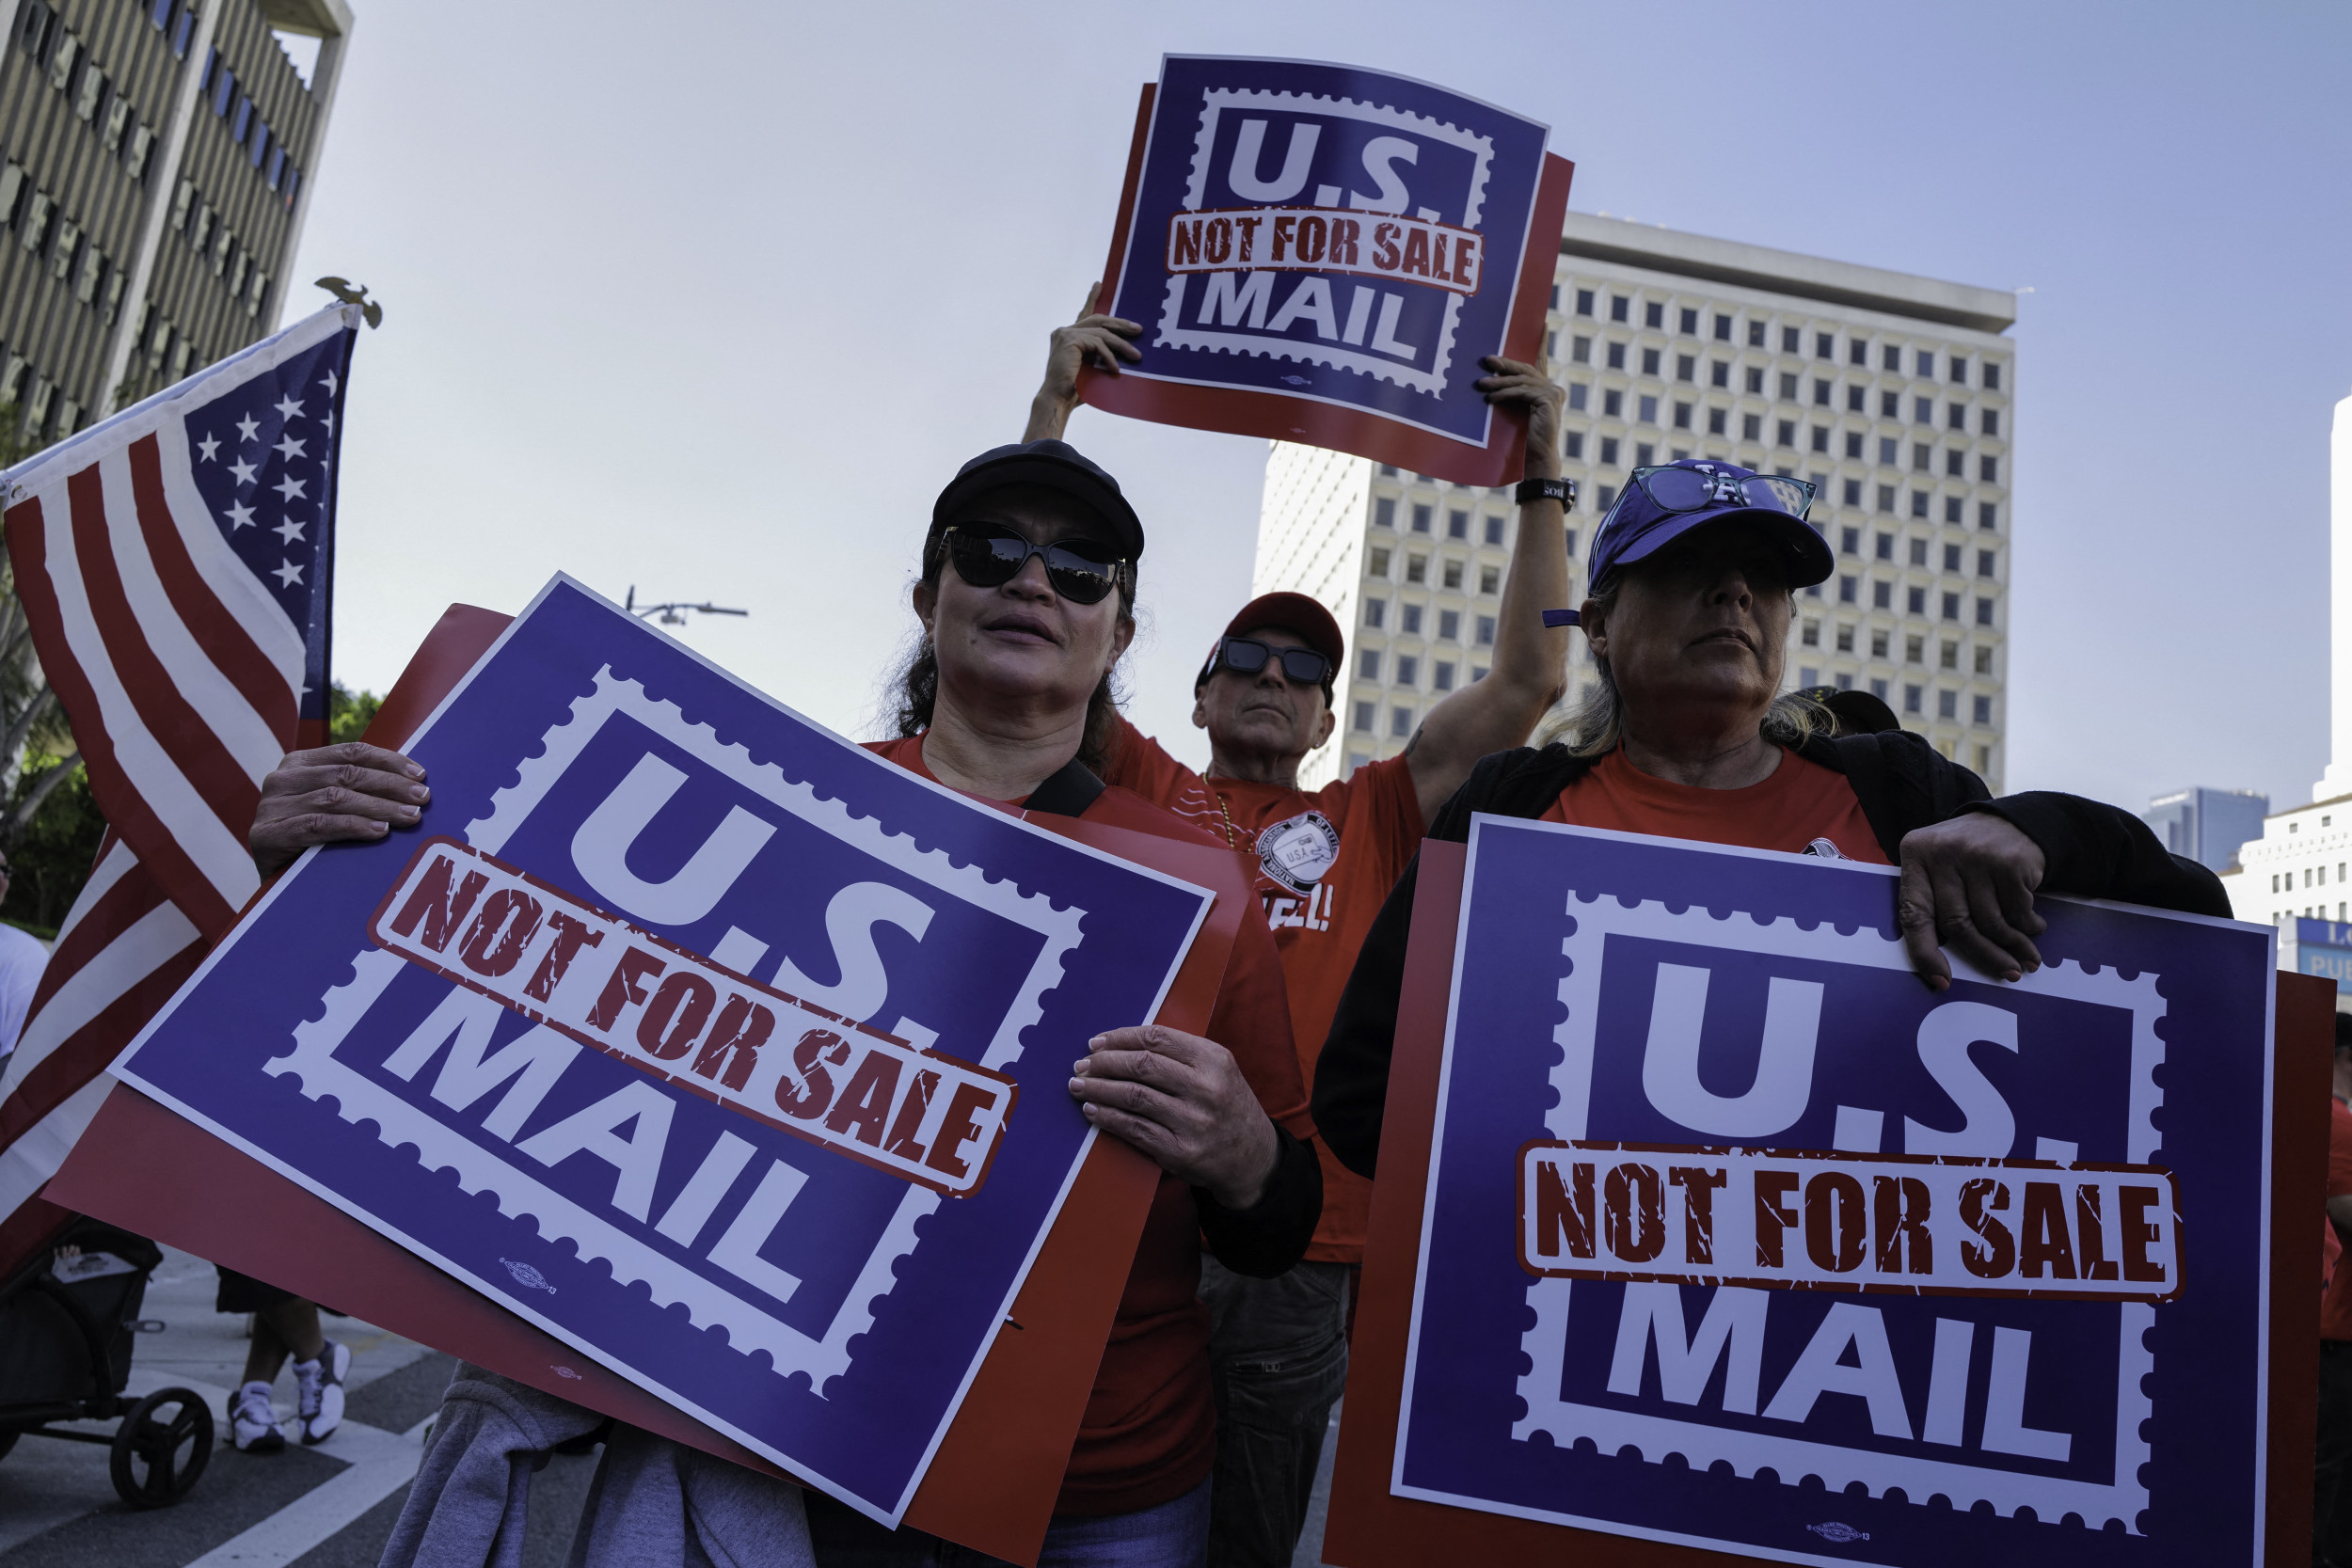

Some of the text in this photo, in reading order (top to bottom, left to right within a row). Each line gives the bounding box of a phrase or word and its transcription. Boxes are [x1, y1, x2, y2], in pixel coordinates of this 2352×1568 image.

[1228, 119, 1441, 223] U.S.
[1173, 216, 1476, 286] NOT FOR SALE
[1197, 270, 1417, 361] MAIL
[1316, 817, 1326, 828] OF
[571, 751, 941, 1052] U.S.
[389, 853, 997, 1180] NOT FOR SALE
[1642, 962, 2078, 1164] U.S.
[381, 983, 811, 1305] MAIL
[1535, 1160, 2166, 1283] NOT FOR SALE
[548, 1286, 557, 1295] 13
[1607, 1281, 2072, 1463] MAIL
[1862, 1532, 1870, 1541] 13
